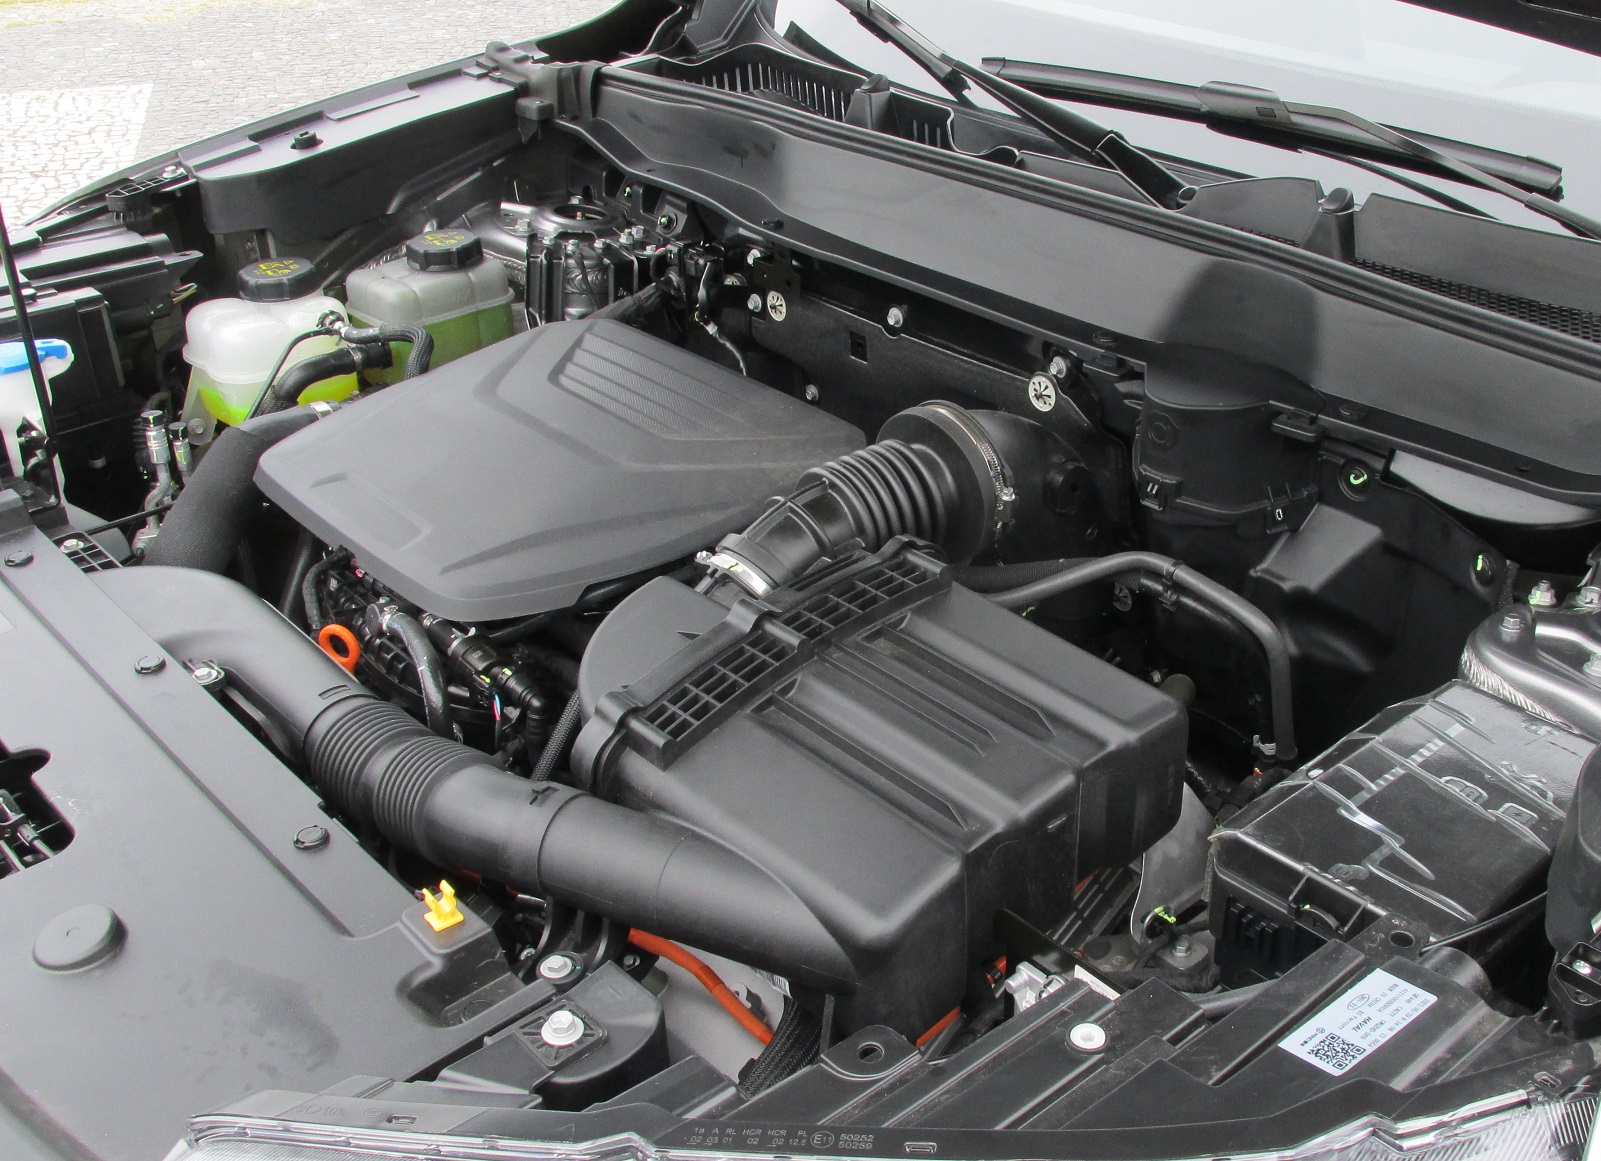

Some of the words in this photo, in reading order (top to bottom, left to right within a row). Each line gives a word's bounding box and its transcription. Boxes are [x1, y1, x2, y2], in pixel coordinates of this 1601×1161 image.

[1350, 1016, 1373, 1031] HAVAL
[840, 1133, 874, 1142] 50252
[838, 1141, 873, 1150] 50259
